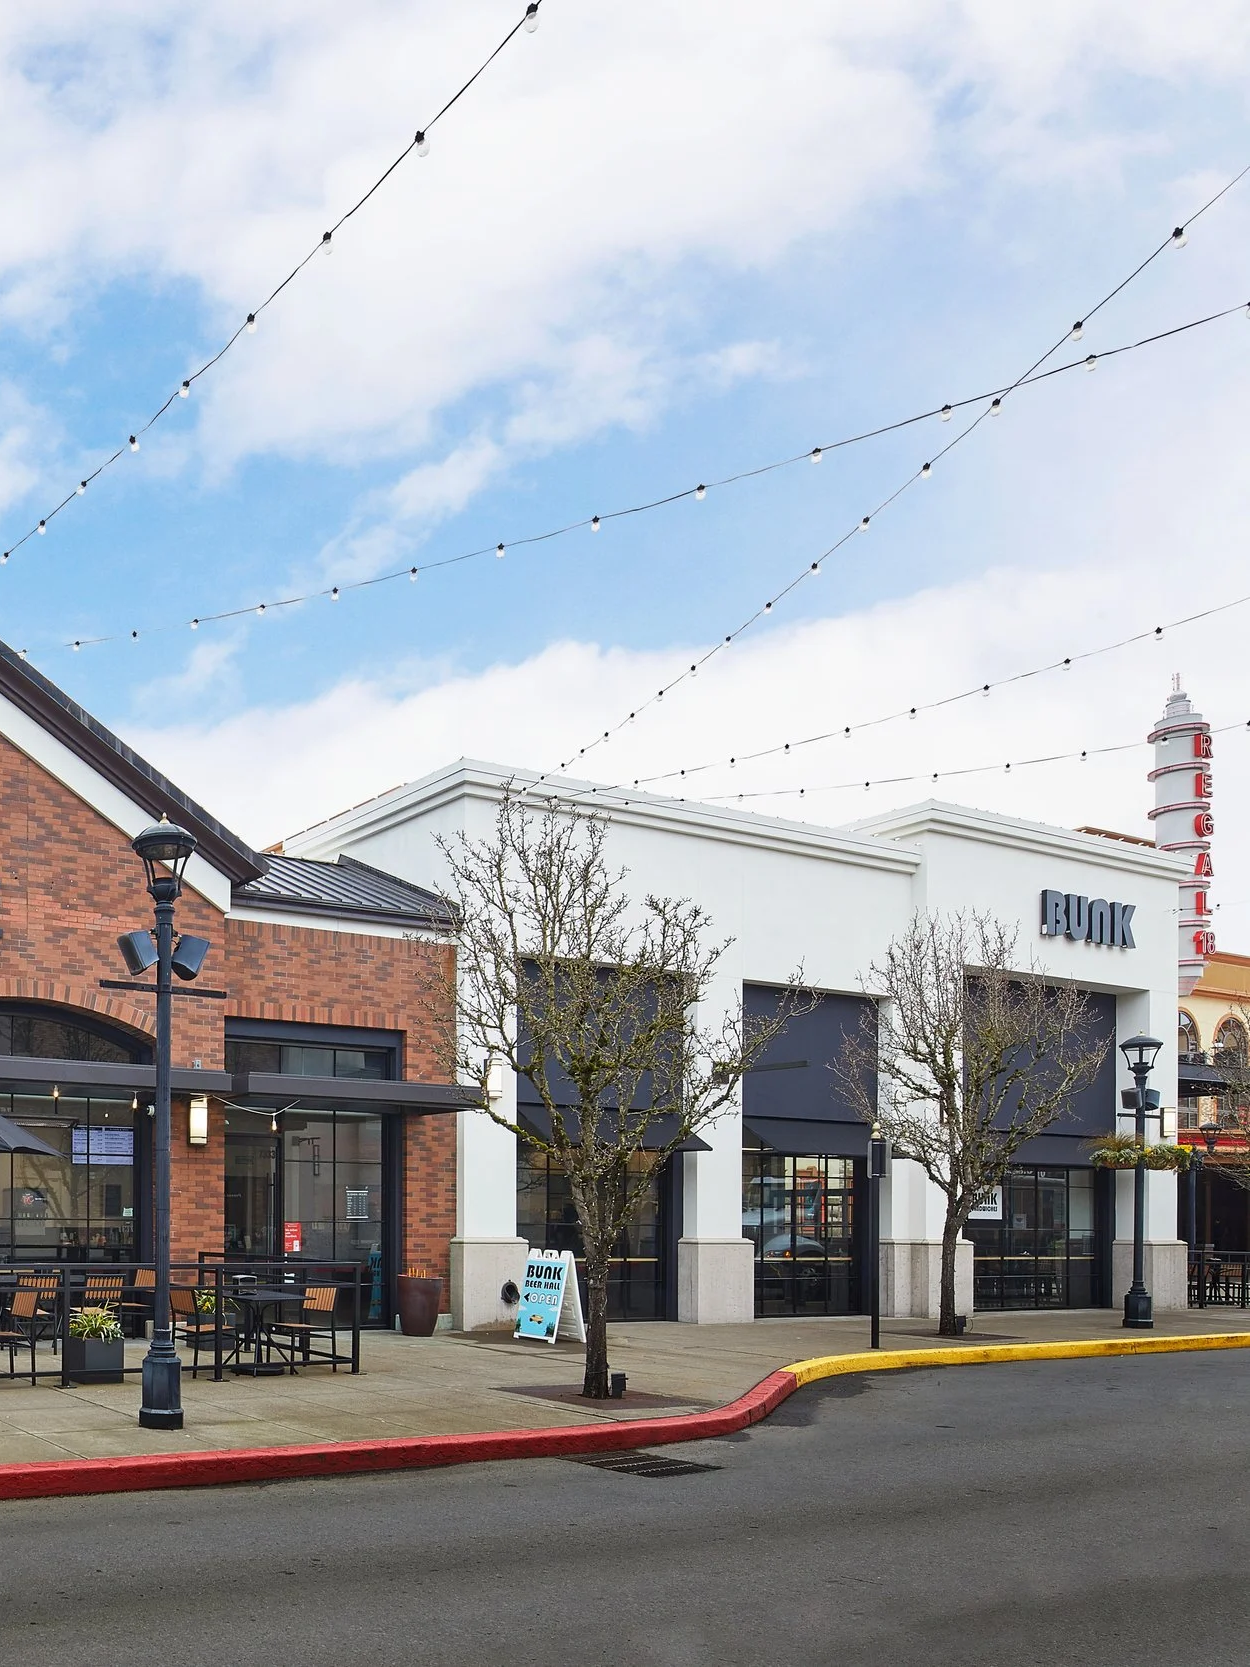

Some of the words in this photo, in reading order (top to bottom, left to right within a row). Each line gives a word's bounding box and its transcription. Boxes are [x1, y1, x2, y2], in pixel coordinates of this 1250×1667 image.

[1194, 733, 1214, 916] REGAL
[1041, 889, 1137, 948] BUNK
[1193, 930, 1216, 955] 18
[526, 1264, 563, 1280] BUNK
[525, 1280, 542, 1289] BEER
[544, 1281, 560, 1290] HALL
[530, 1292, 558, 1305] OPEN
